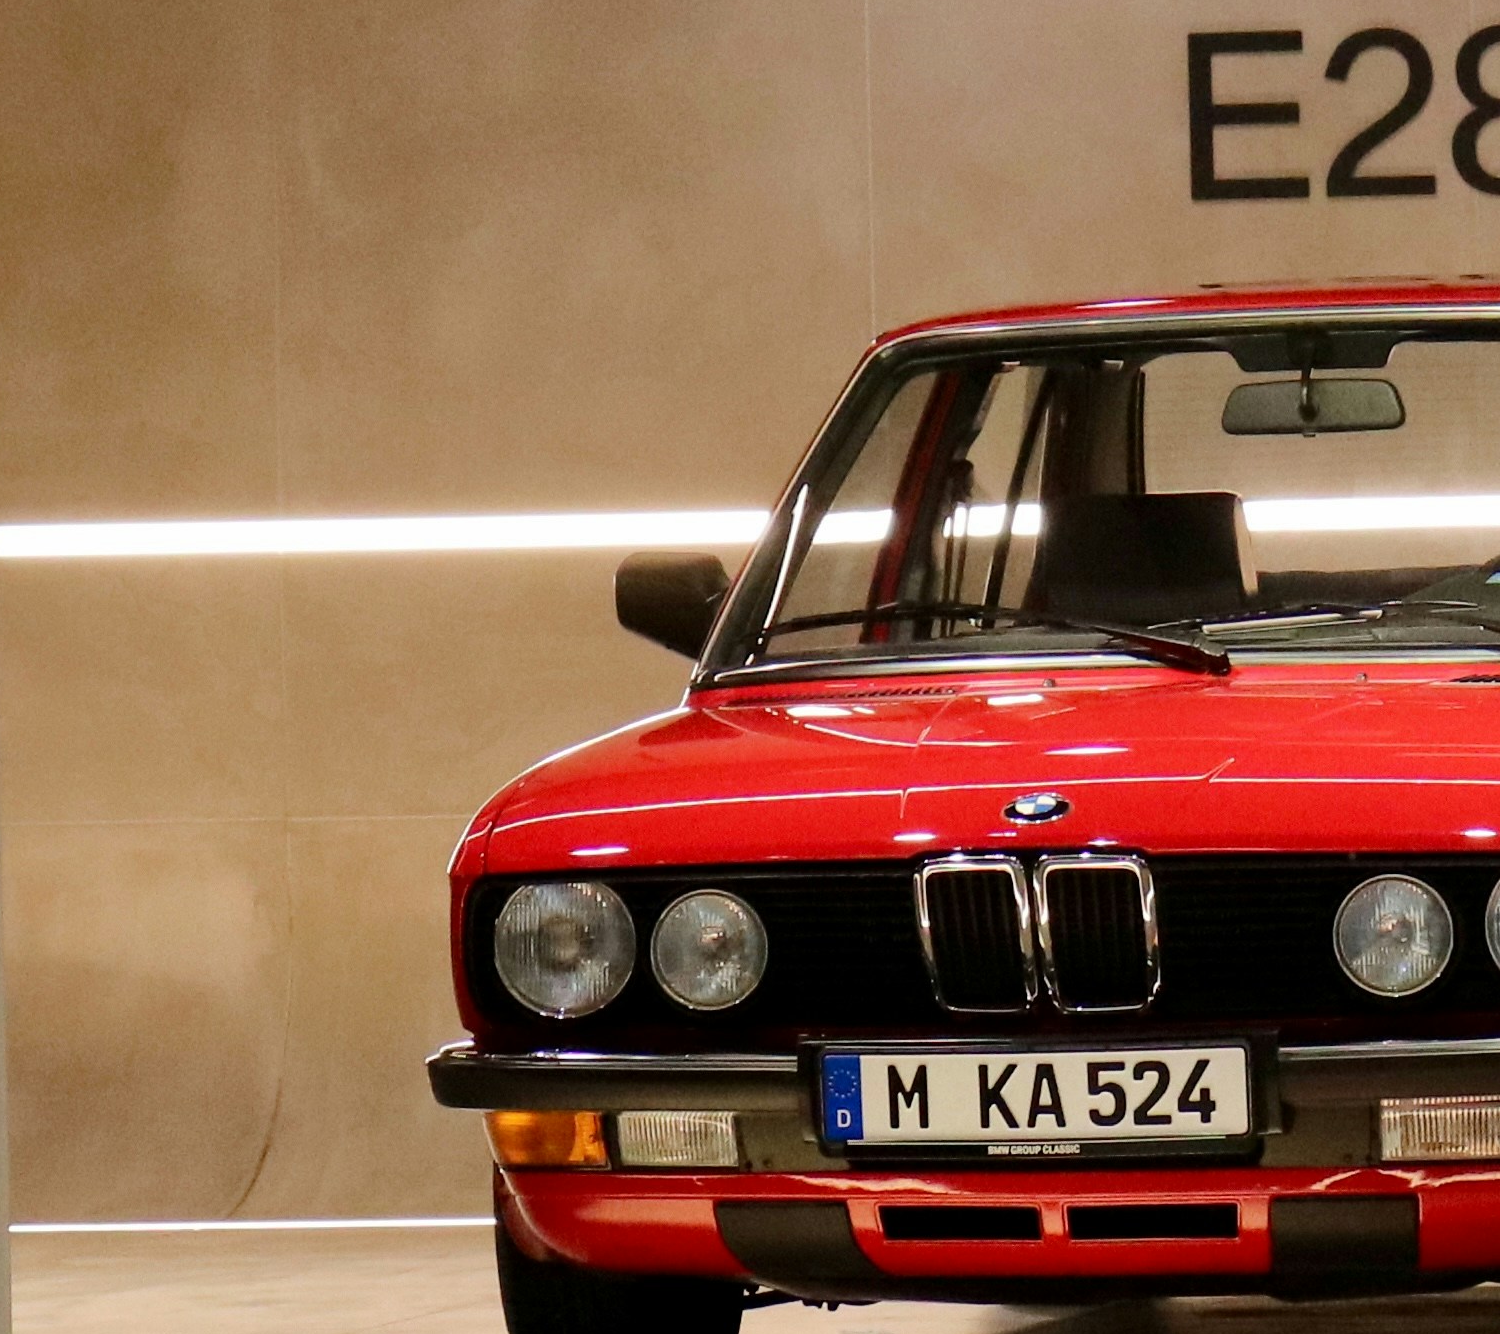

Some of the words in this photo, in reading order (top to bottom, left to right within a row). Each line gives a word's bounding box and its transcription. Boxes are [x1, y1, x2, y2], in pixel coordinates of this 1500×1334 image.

[887, 1064, 929, 1129] M
[977, 1063, 1067, 1129] KA
[1086, 1058, 1217, 1127] 524
[836, 1110, 851, 1128] D
[987, 1145, 1010, 1155] BMW
[1010, 1145, 1042, 1155] GROUP
[1042, 1143, 1081, 1154] CLASSIC
